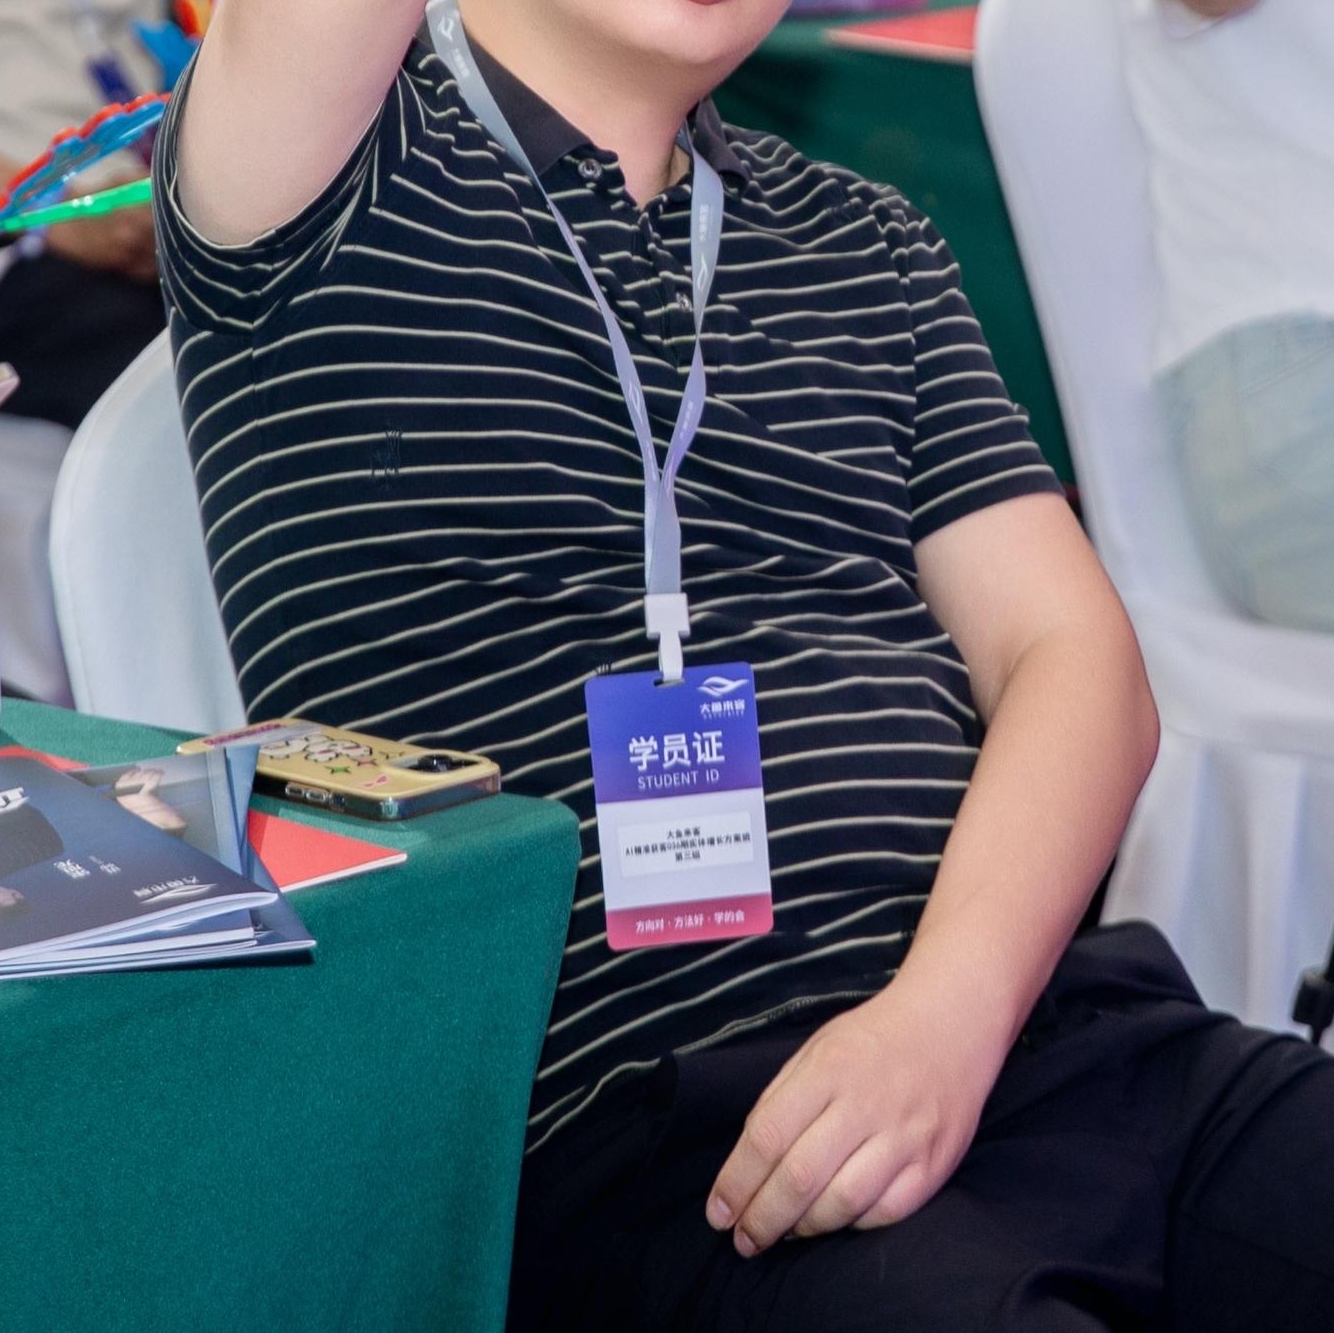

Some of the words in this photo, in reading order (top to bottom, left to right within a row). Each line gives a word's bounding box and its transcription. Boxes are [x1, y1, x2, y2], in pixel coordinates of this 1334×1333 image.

[629, 730, 725, 771] 学员证
[638, 771, 699, 789] STUDENT
[706, 769, 720, 783] ID
